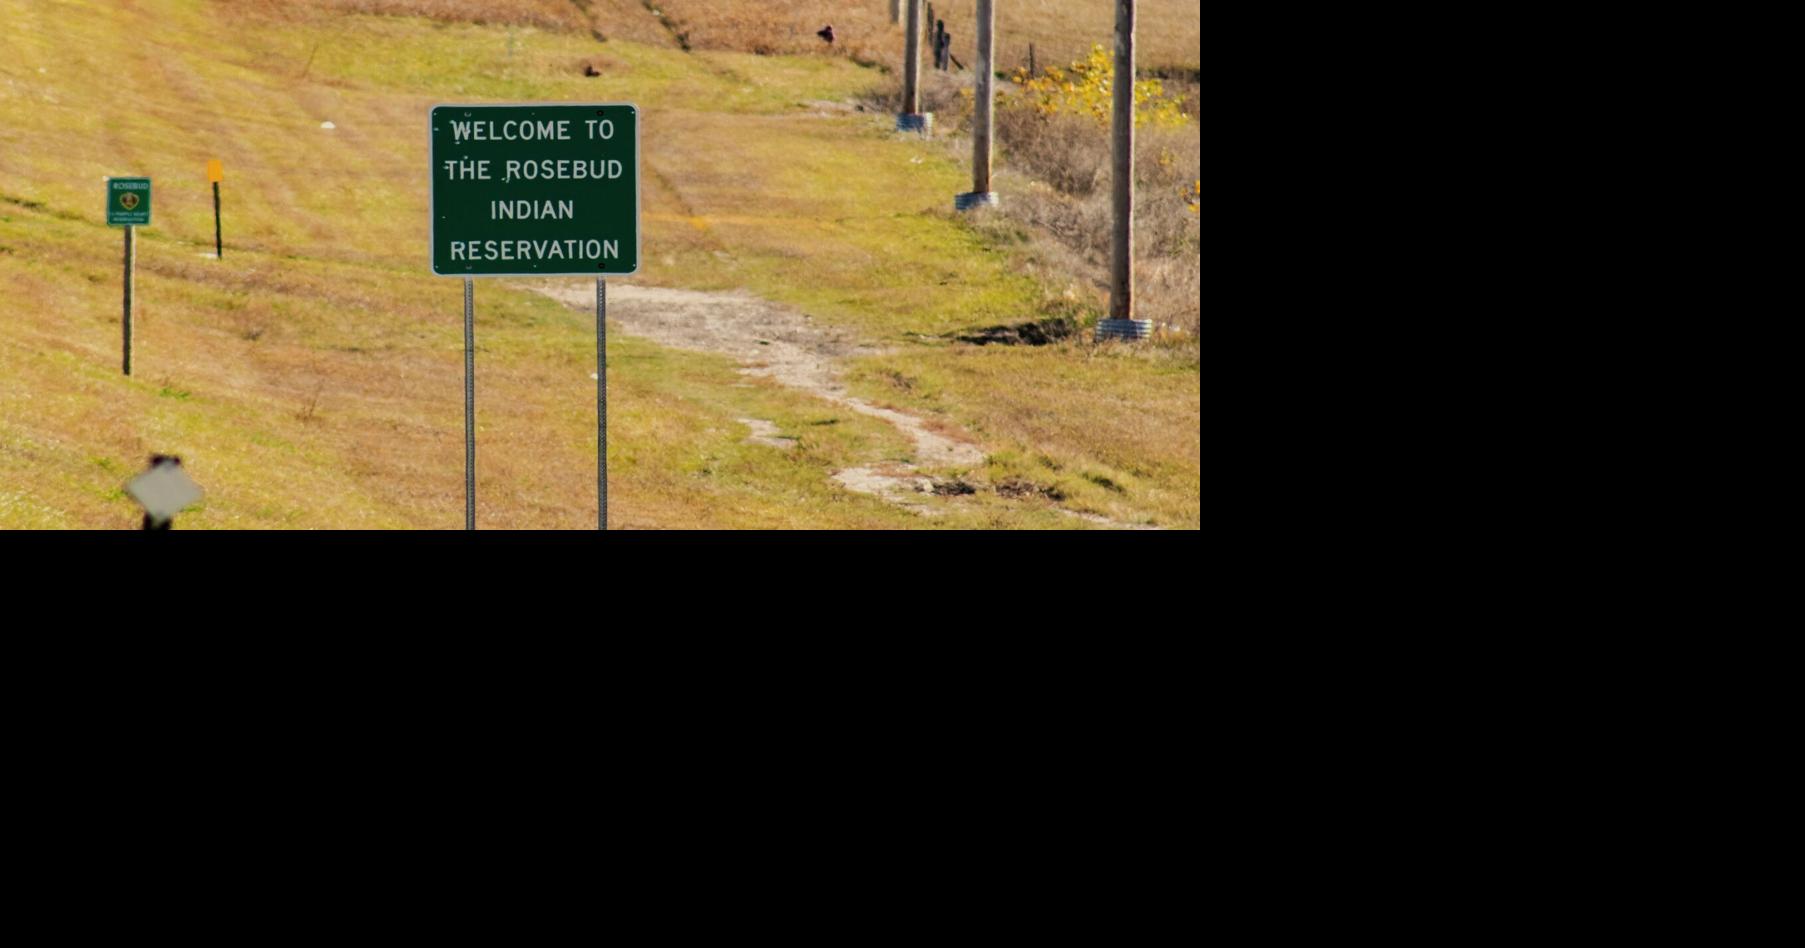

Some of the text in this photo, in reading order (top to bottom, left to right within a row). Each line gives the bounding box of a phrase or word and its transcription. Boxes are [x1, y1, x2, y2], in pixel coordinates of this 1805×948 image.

[450, 119, 614, 140] WELCOME TO
[445, 160, 622, 179] THE ROSEBUD
[113, 182, 149, 190] ROSEBUD
[491, 200, 573, 219] INDIAN
[451, 239, 619, 260] RESERVATION
